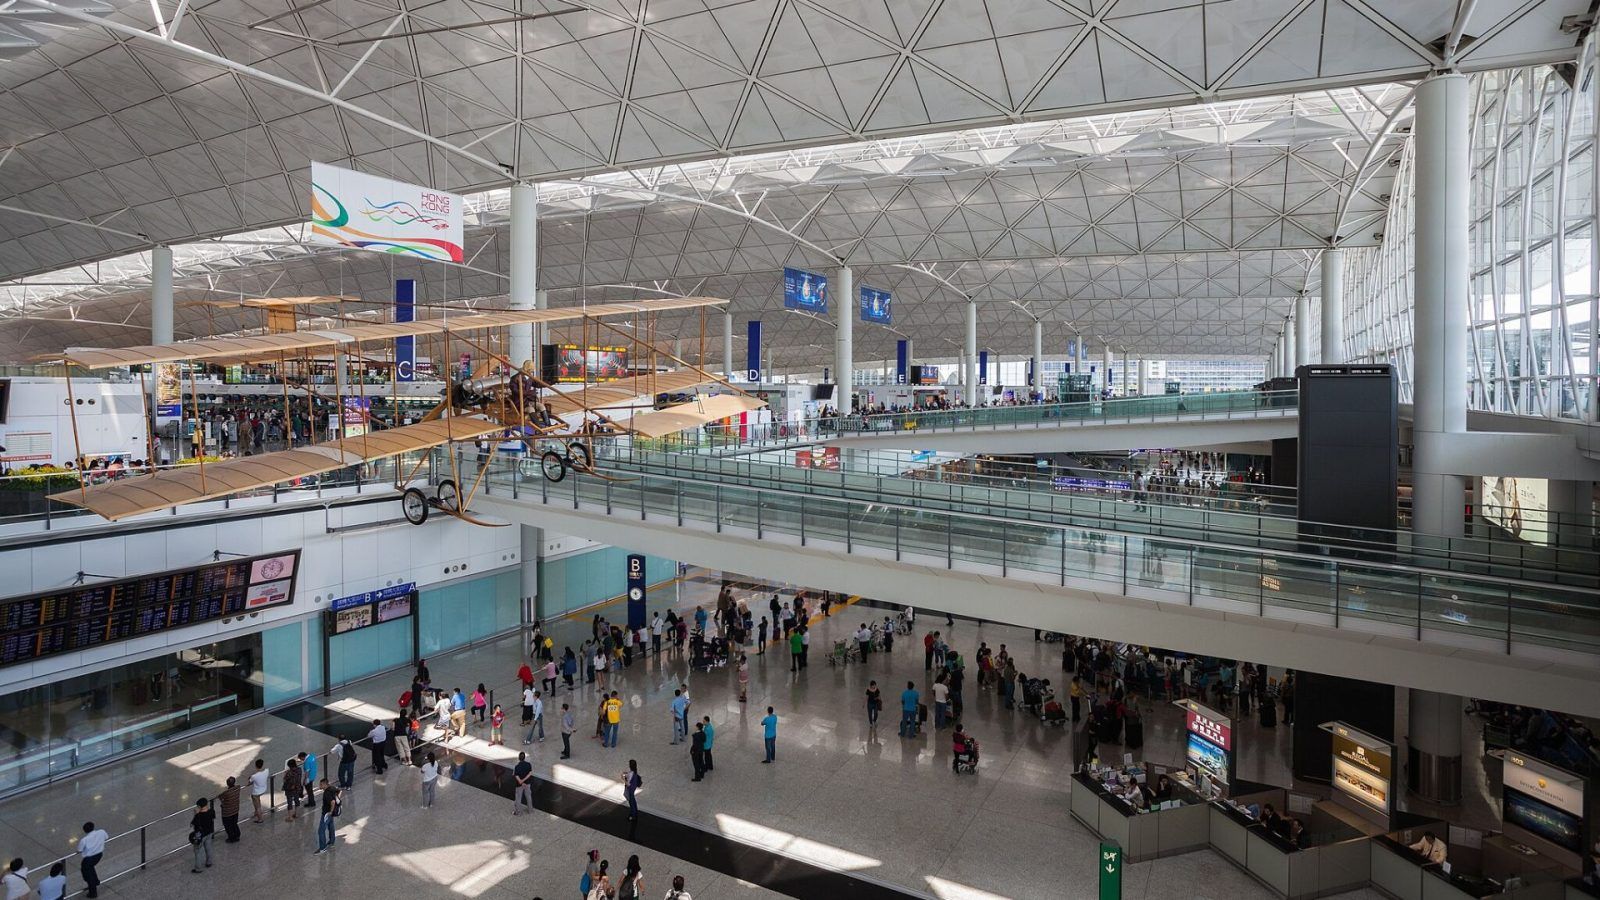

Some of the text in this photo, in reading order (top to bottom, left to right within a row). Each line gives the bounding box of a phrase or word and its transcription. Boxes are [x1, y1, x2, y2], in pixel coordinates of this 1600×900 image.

[421, 192, 450, 205] HONG
[421, 201, 450, 214] KONG
[398, 360, 411, 378] C
[749, 369, 759, 381] D
[898, 374, 904, 382] E
[631, 558, 641, 572] B
[408, 583, 416, 592] A
[364, 592, 371, 603] B
